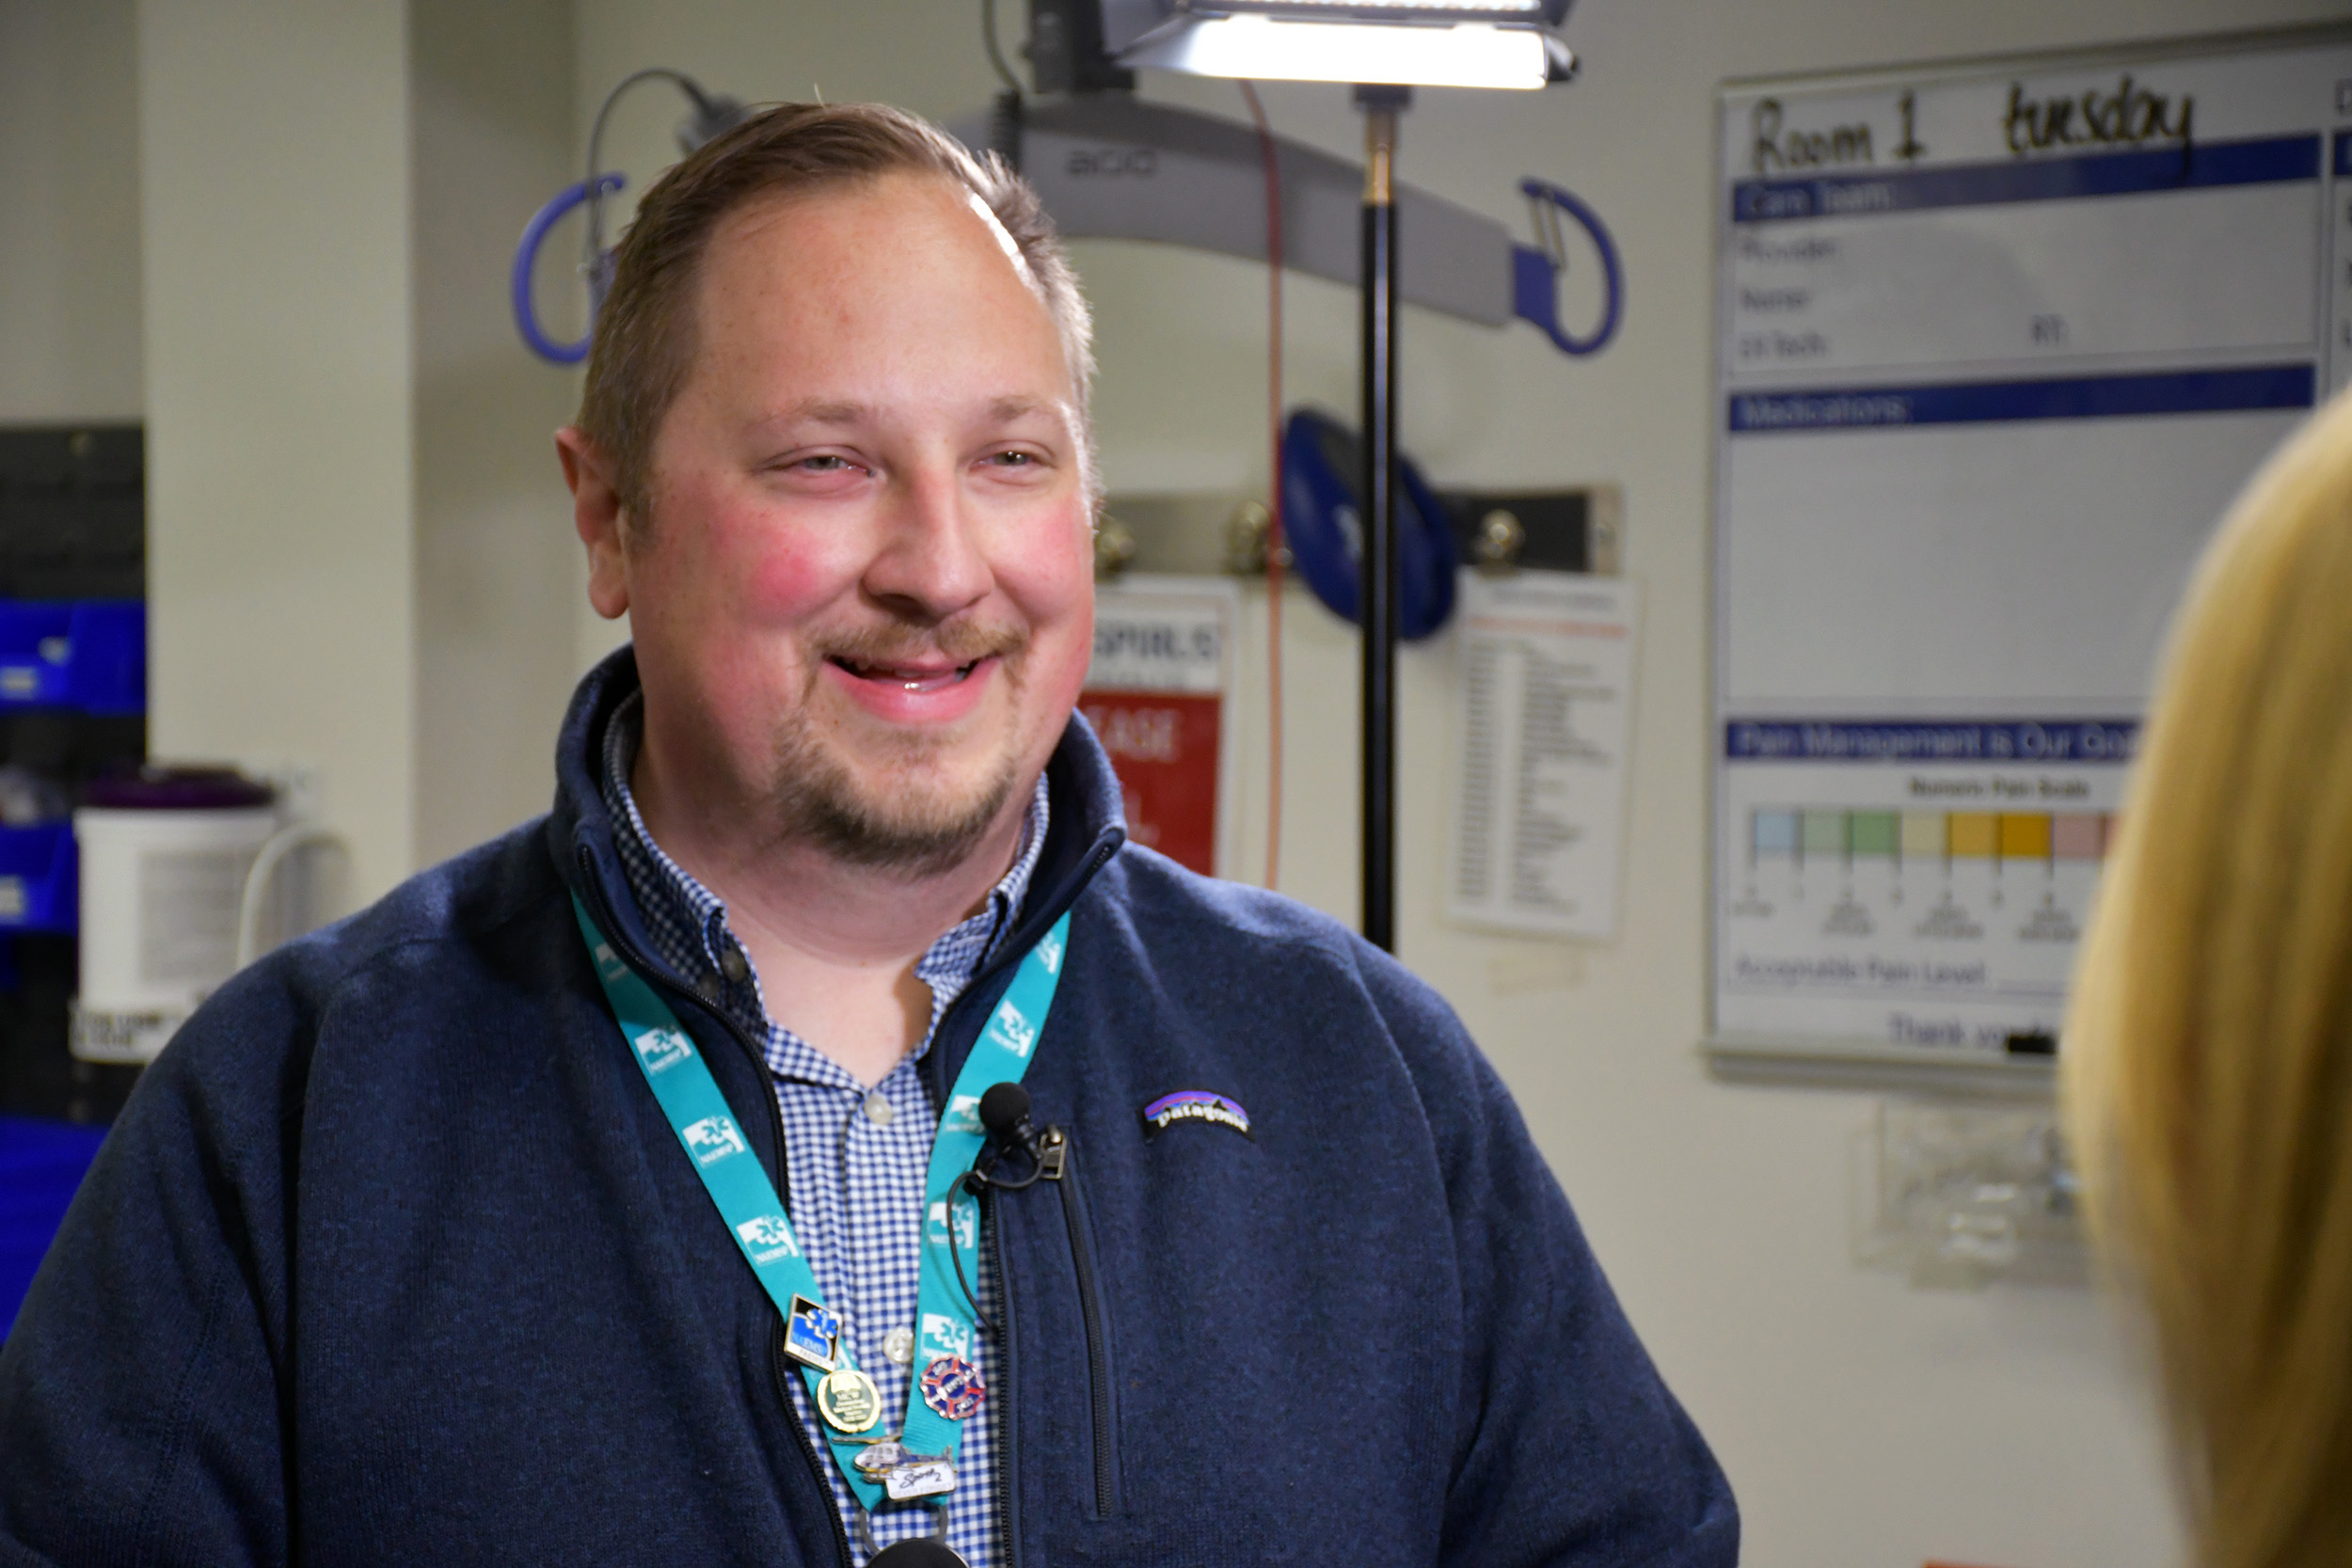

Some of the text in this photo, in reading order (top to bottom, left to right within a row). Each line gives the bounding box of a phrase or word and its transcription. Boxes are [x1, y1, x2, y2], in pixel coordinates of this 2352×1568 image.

[1754, 72, 2193, 179] Room 1 tuesday
[1809, 722, 1981, 761] Management
[2015, 721, 2071, 755] Our
